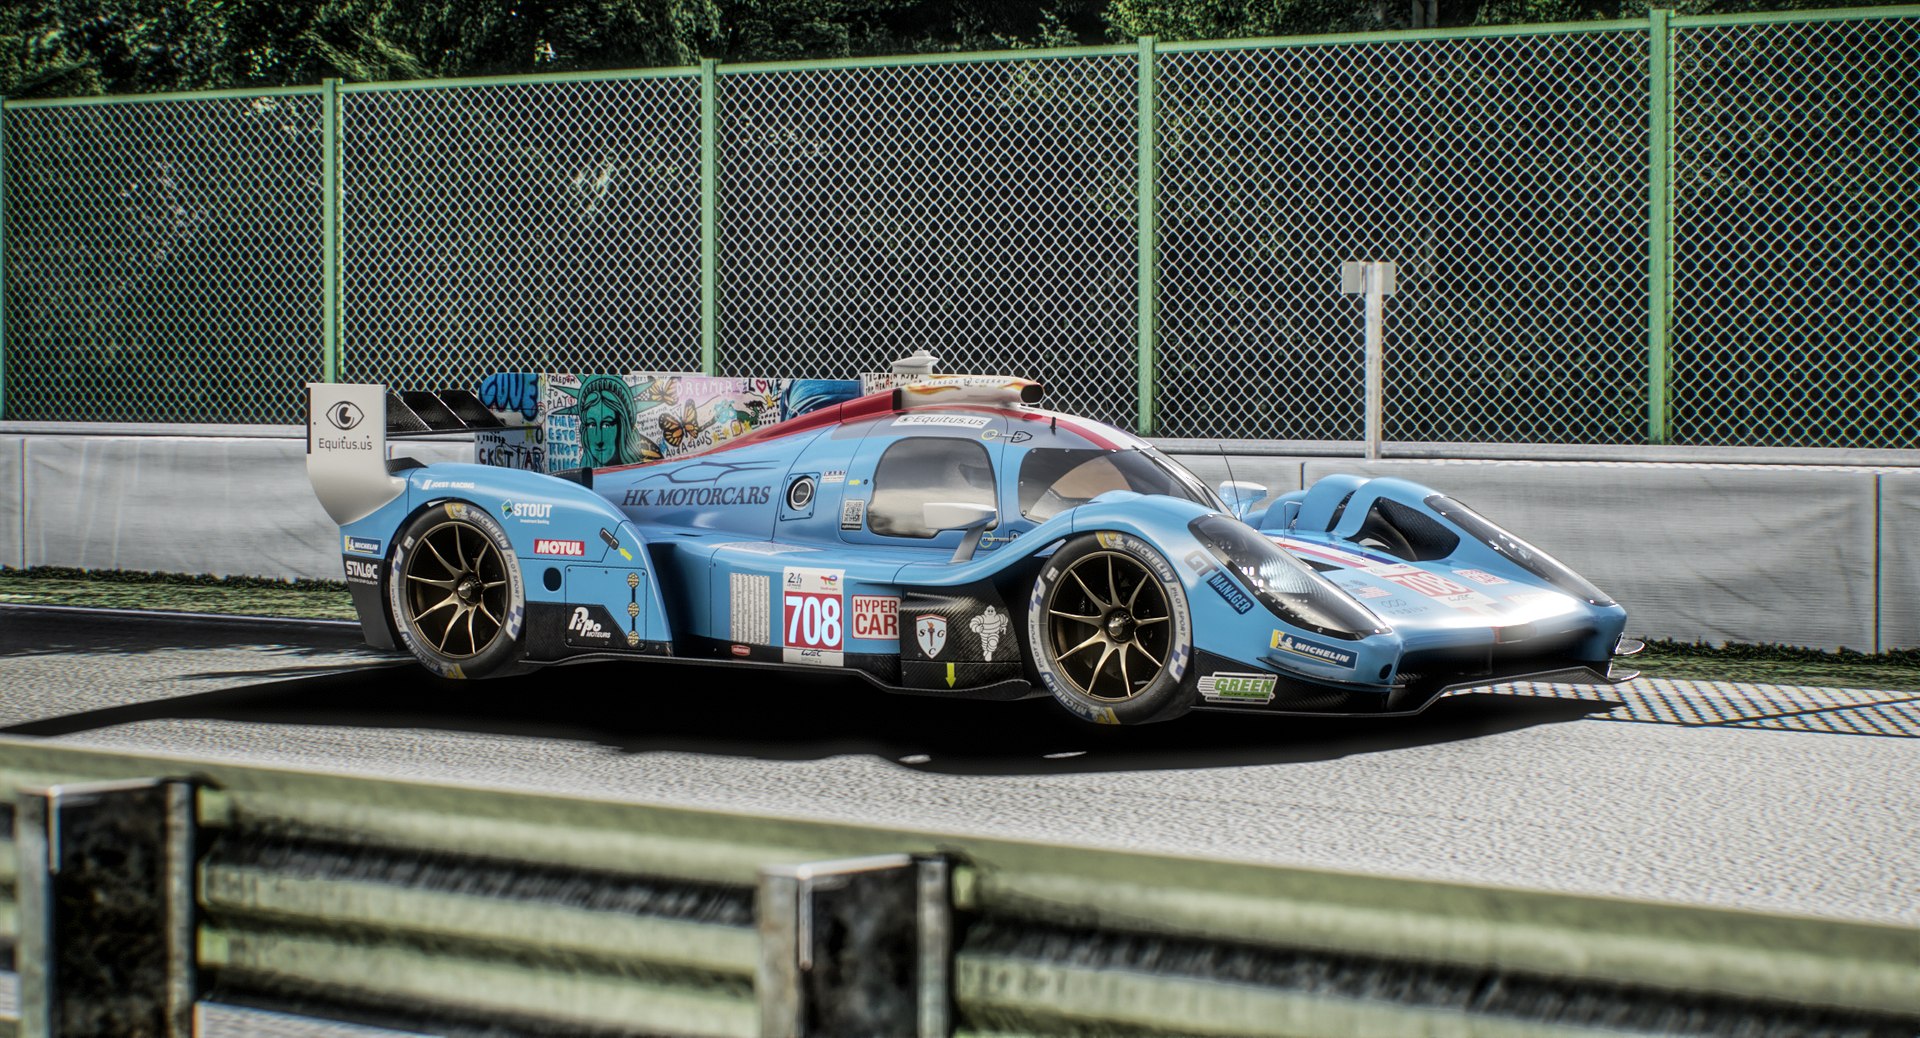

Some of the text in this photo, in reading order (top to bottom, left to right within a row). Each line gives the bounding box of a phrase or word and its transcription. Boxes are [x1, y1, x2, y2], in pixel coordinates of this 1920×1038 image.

[676, 380, 742, 396] DREAMERS
[914, 415, 985, 428] Equitus.us
[318, 437, 373, 452] Equitus.us
[622, 486, 771, 506] HK MOTORCARS
[514, 503, 552, 519] STOUT
[469, 510, 509, 549] MICHELIN
[536, 540, 582, 556] MOTUL
[346, 560, 378, 580] STALOC
[1126, 539, 1173, 581] MICHELIN
[506, 553, 521, 599] PILOT SPORT
[1210, 573, 1252, 613] MANAGER
[855, 599, 898, 614] HYPER
[1171, 586, 1186, 637] PILOT SPORT
[785, 595, 841, 647] 708
[855, 613, 898, 636] CAR
[401, 632, 440, 672] MICHELIN
[1033, 645, 1044, 668] PILOT
[1294, 642, 1350, 663] MICHELIN
[1043, 672, 1089, 716] MICHELIN
[1215, 677, 1275, 693] GREEN
